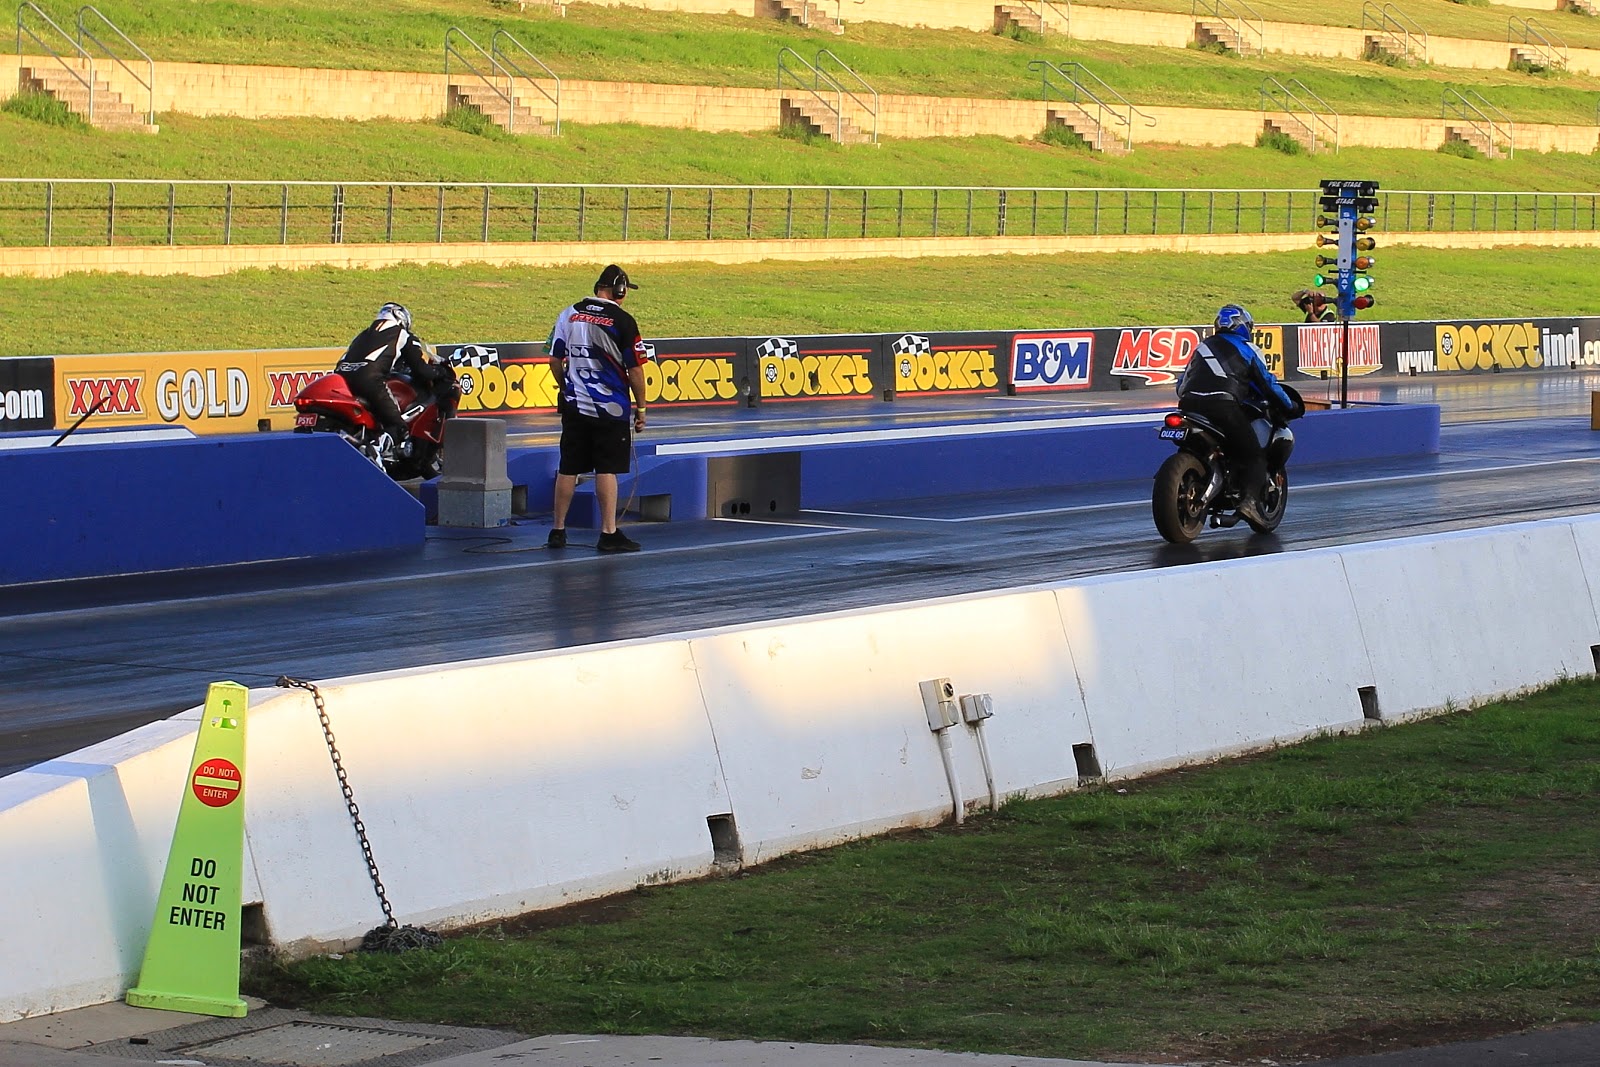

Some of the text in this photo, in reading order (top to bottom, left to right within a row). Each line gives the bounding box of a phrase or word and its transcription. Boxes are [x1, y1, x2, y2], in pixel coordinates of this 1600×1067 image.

[1112, 328, 1200, 369] MSD
[1299, 327, 1334, 368] MICKEY
[1332, 326, 1380, 367] THMPSON
[1015, 340, 1088, 384] B&M
[629, 358, 738, 402] OCKet
[67, 367, 250, 421] XXXX GOLD
[297, 416, 314, 425] PSYC
[203, 766, 235, 778] DO NOT
[202, 788, 228, 799] ENTER
[190, 857, 217, 879] DO
[182, 883, 220, 905] NOT
[169, 906, 226, 931] ENTER
